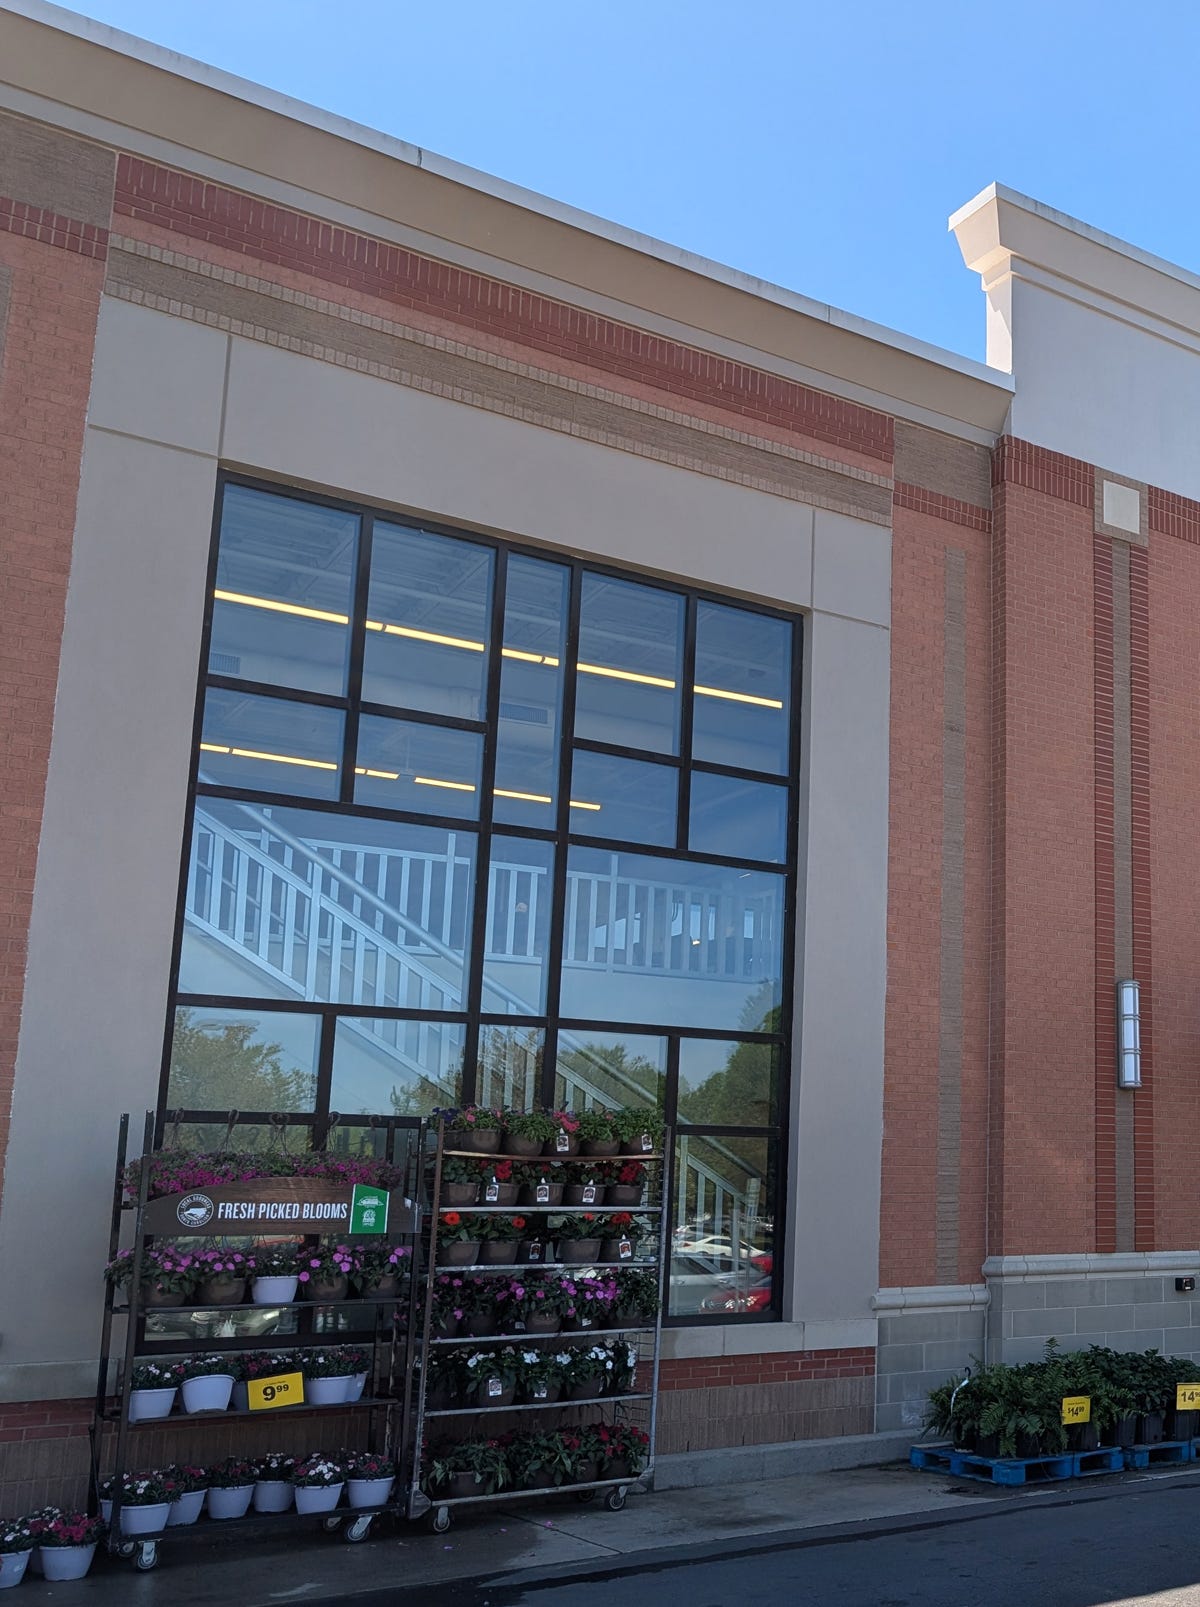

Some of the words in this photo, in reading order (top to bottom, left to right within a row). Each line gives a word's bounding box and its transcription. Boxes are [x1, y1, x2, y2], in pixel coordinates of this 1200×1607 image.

[218, 1203, 256, 1219] FRESH
[258, 1203, 300, 1219] PICKED
[302, 1203, 348, 1219] BLOOMS
